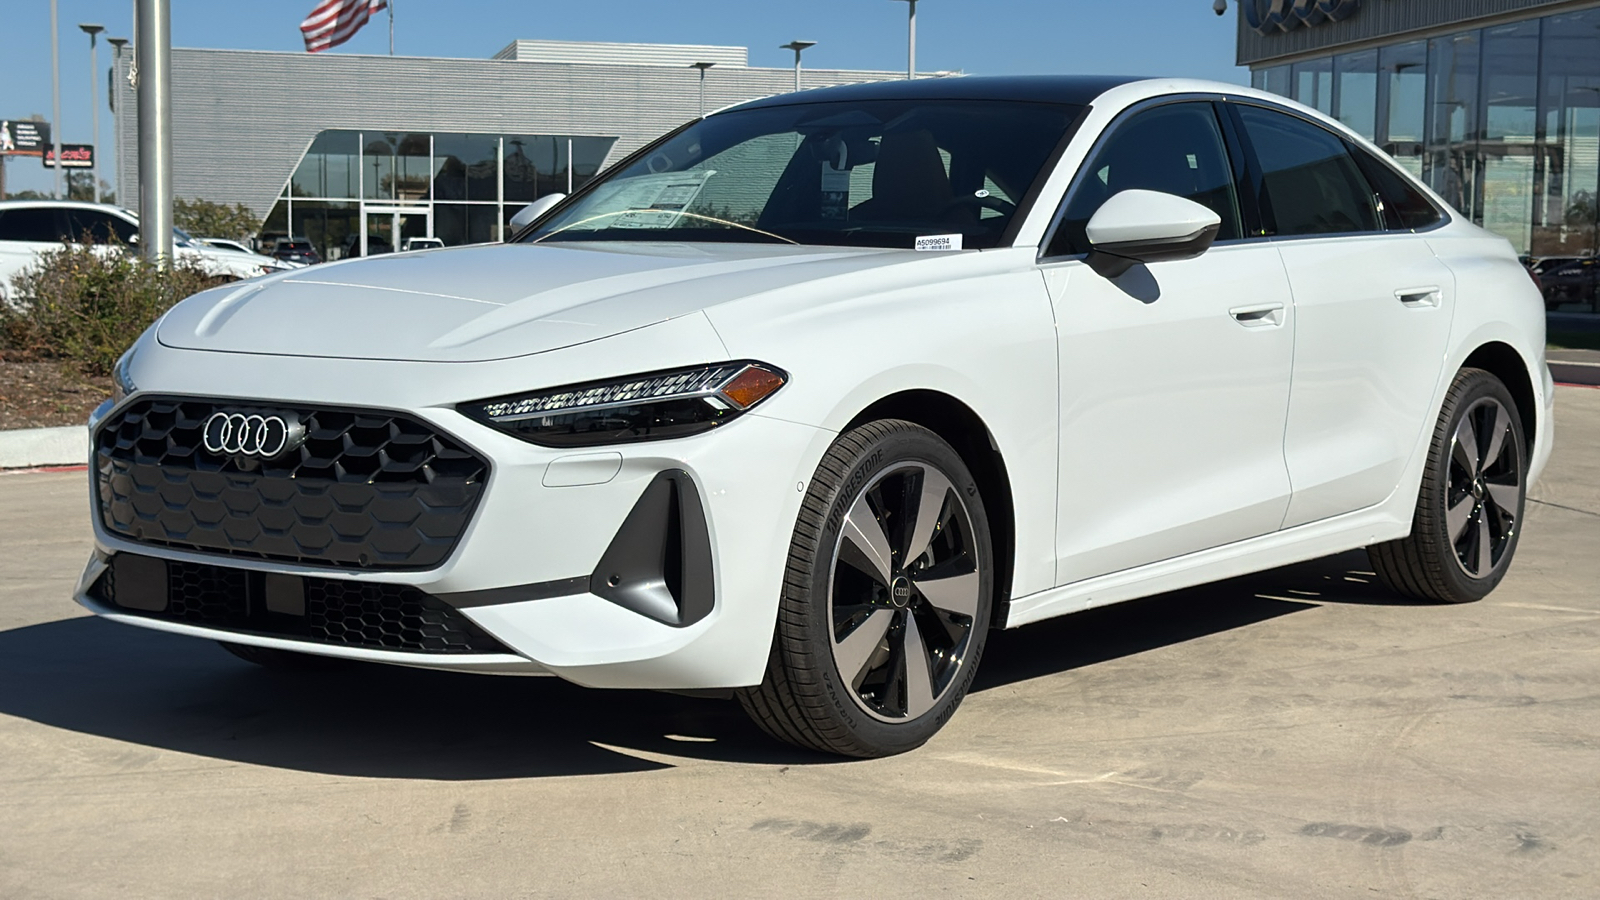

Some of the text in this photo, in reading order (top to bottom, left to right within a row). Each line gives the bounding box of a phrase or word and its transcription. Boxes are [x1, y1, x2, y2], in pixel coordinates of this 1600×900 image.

[917, 238, 950, 246] A5099694
[827, 449, 884, 536] BRIDGESTONE
[823, 671, 858, 729] TURANZA
